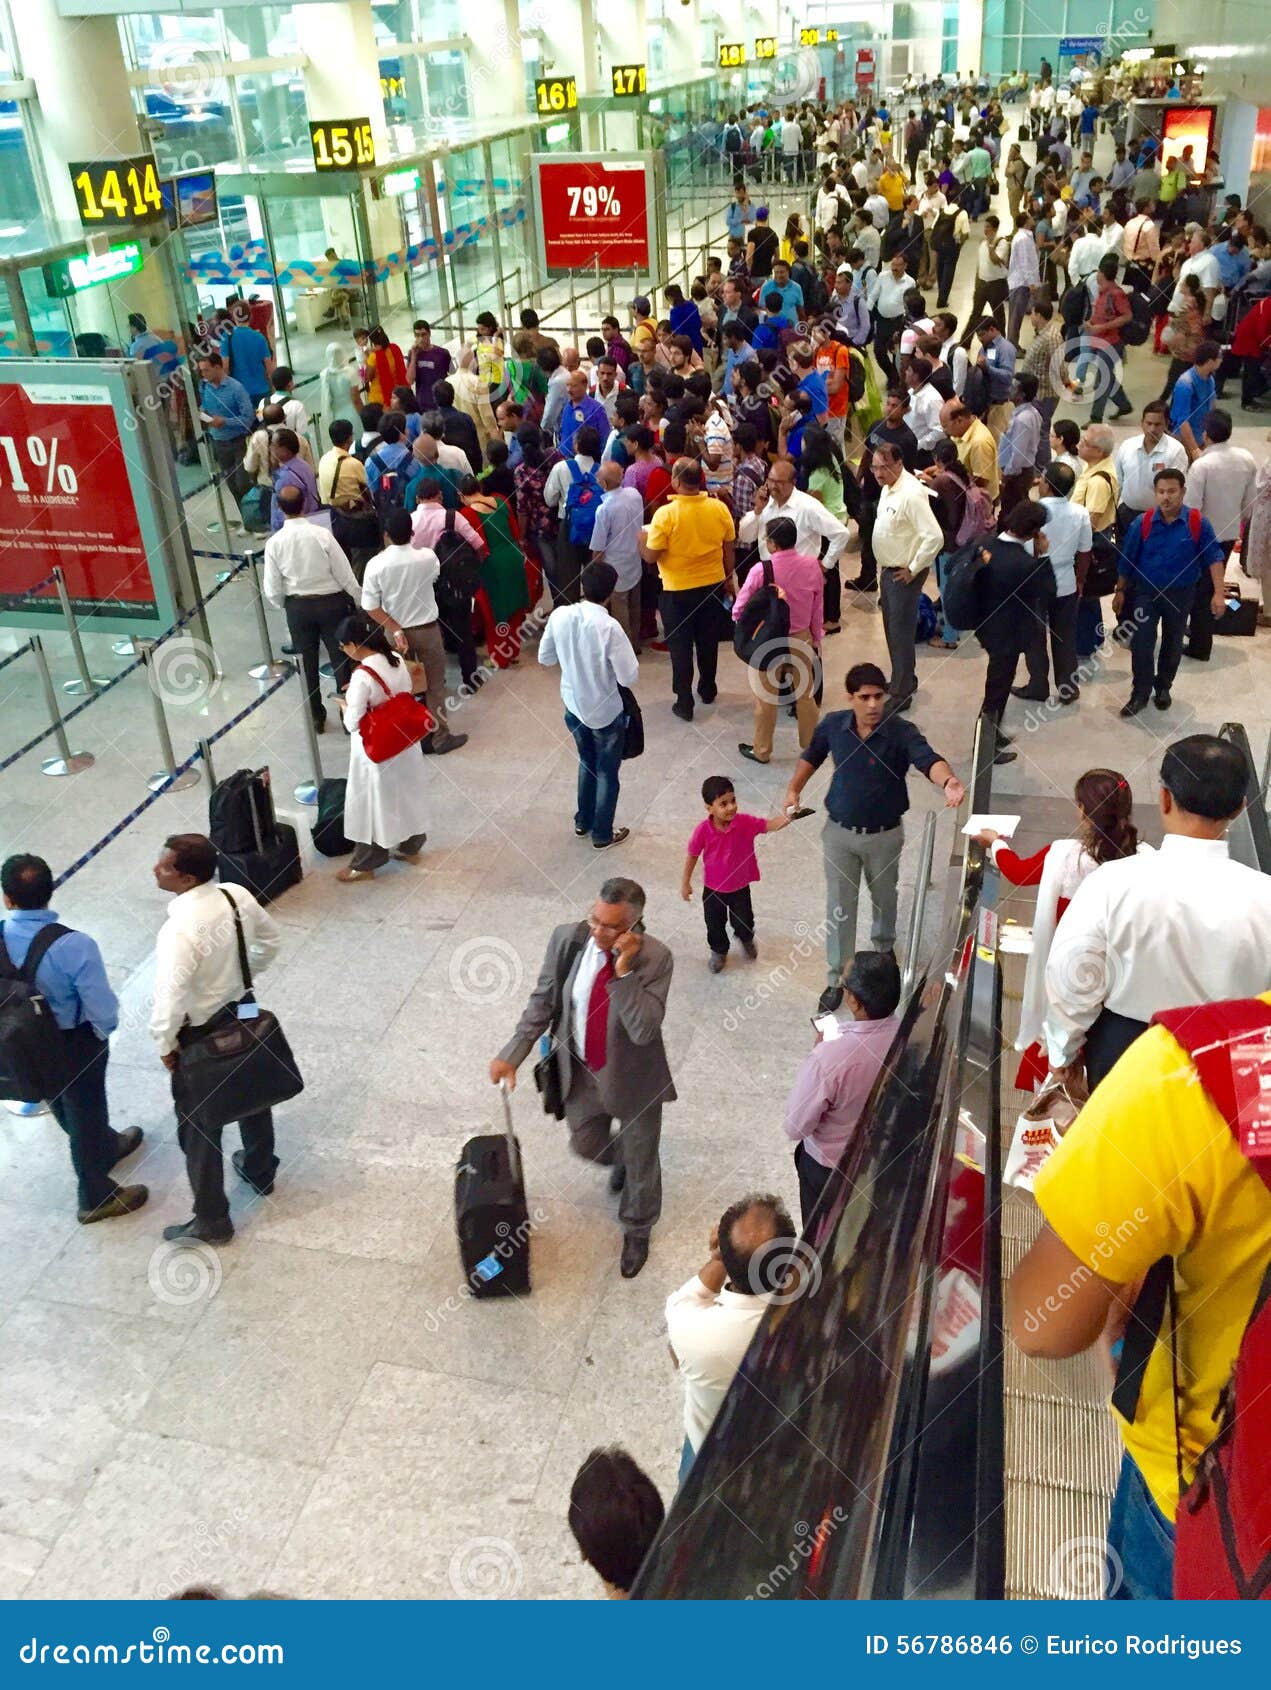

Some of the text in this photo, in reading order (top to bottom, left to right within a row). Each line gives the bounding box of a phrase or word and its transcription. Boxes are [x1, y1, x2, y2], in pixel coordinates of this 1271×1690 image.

[721, 46, 740, 66] 18
[537, 82, 566, 111] 16
[613, 68, 637, 94] 17
[313, 127, 353, 166] 15
[353, 125, 374, 164] 15
[76, 170, 128, 218] 14
[127, 163, 162, 216] 14
[567, 185, 621, 217] 79%
[0, 436, 79, 494] 1%
